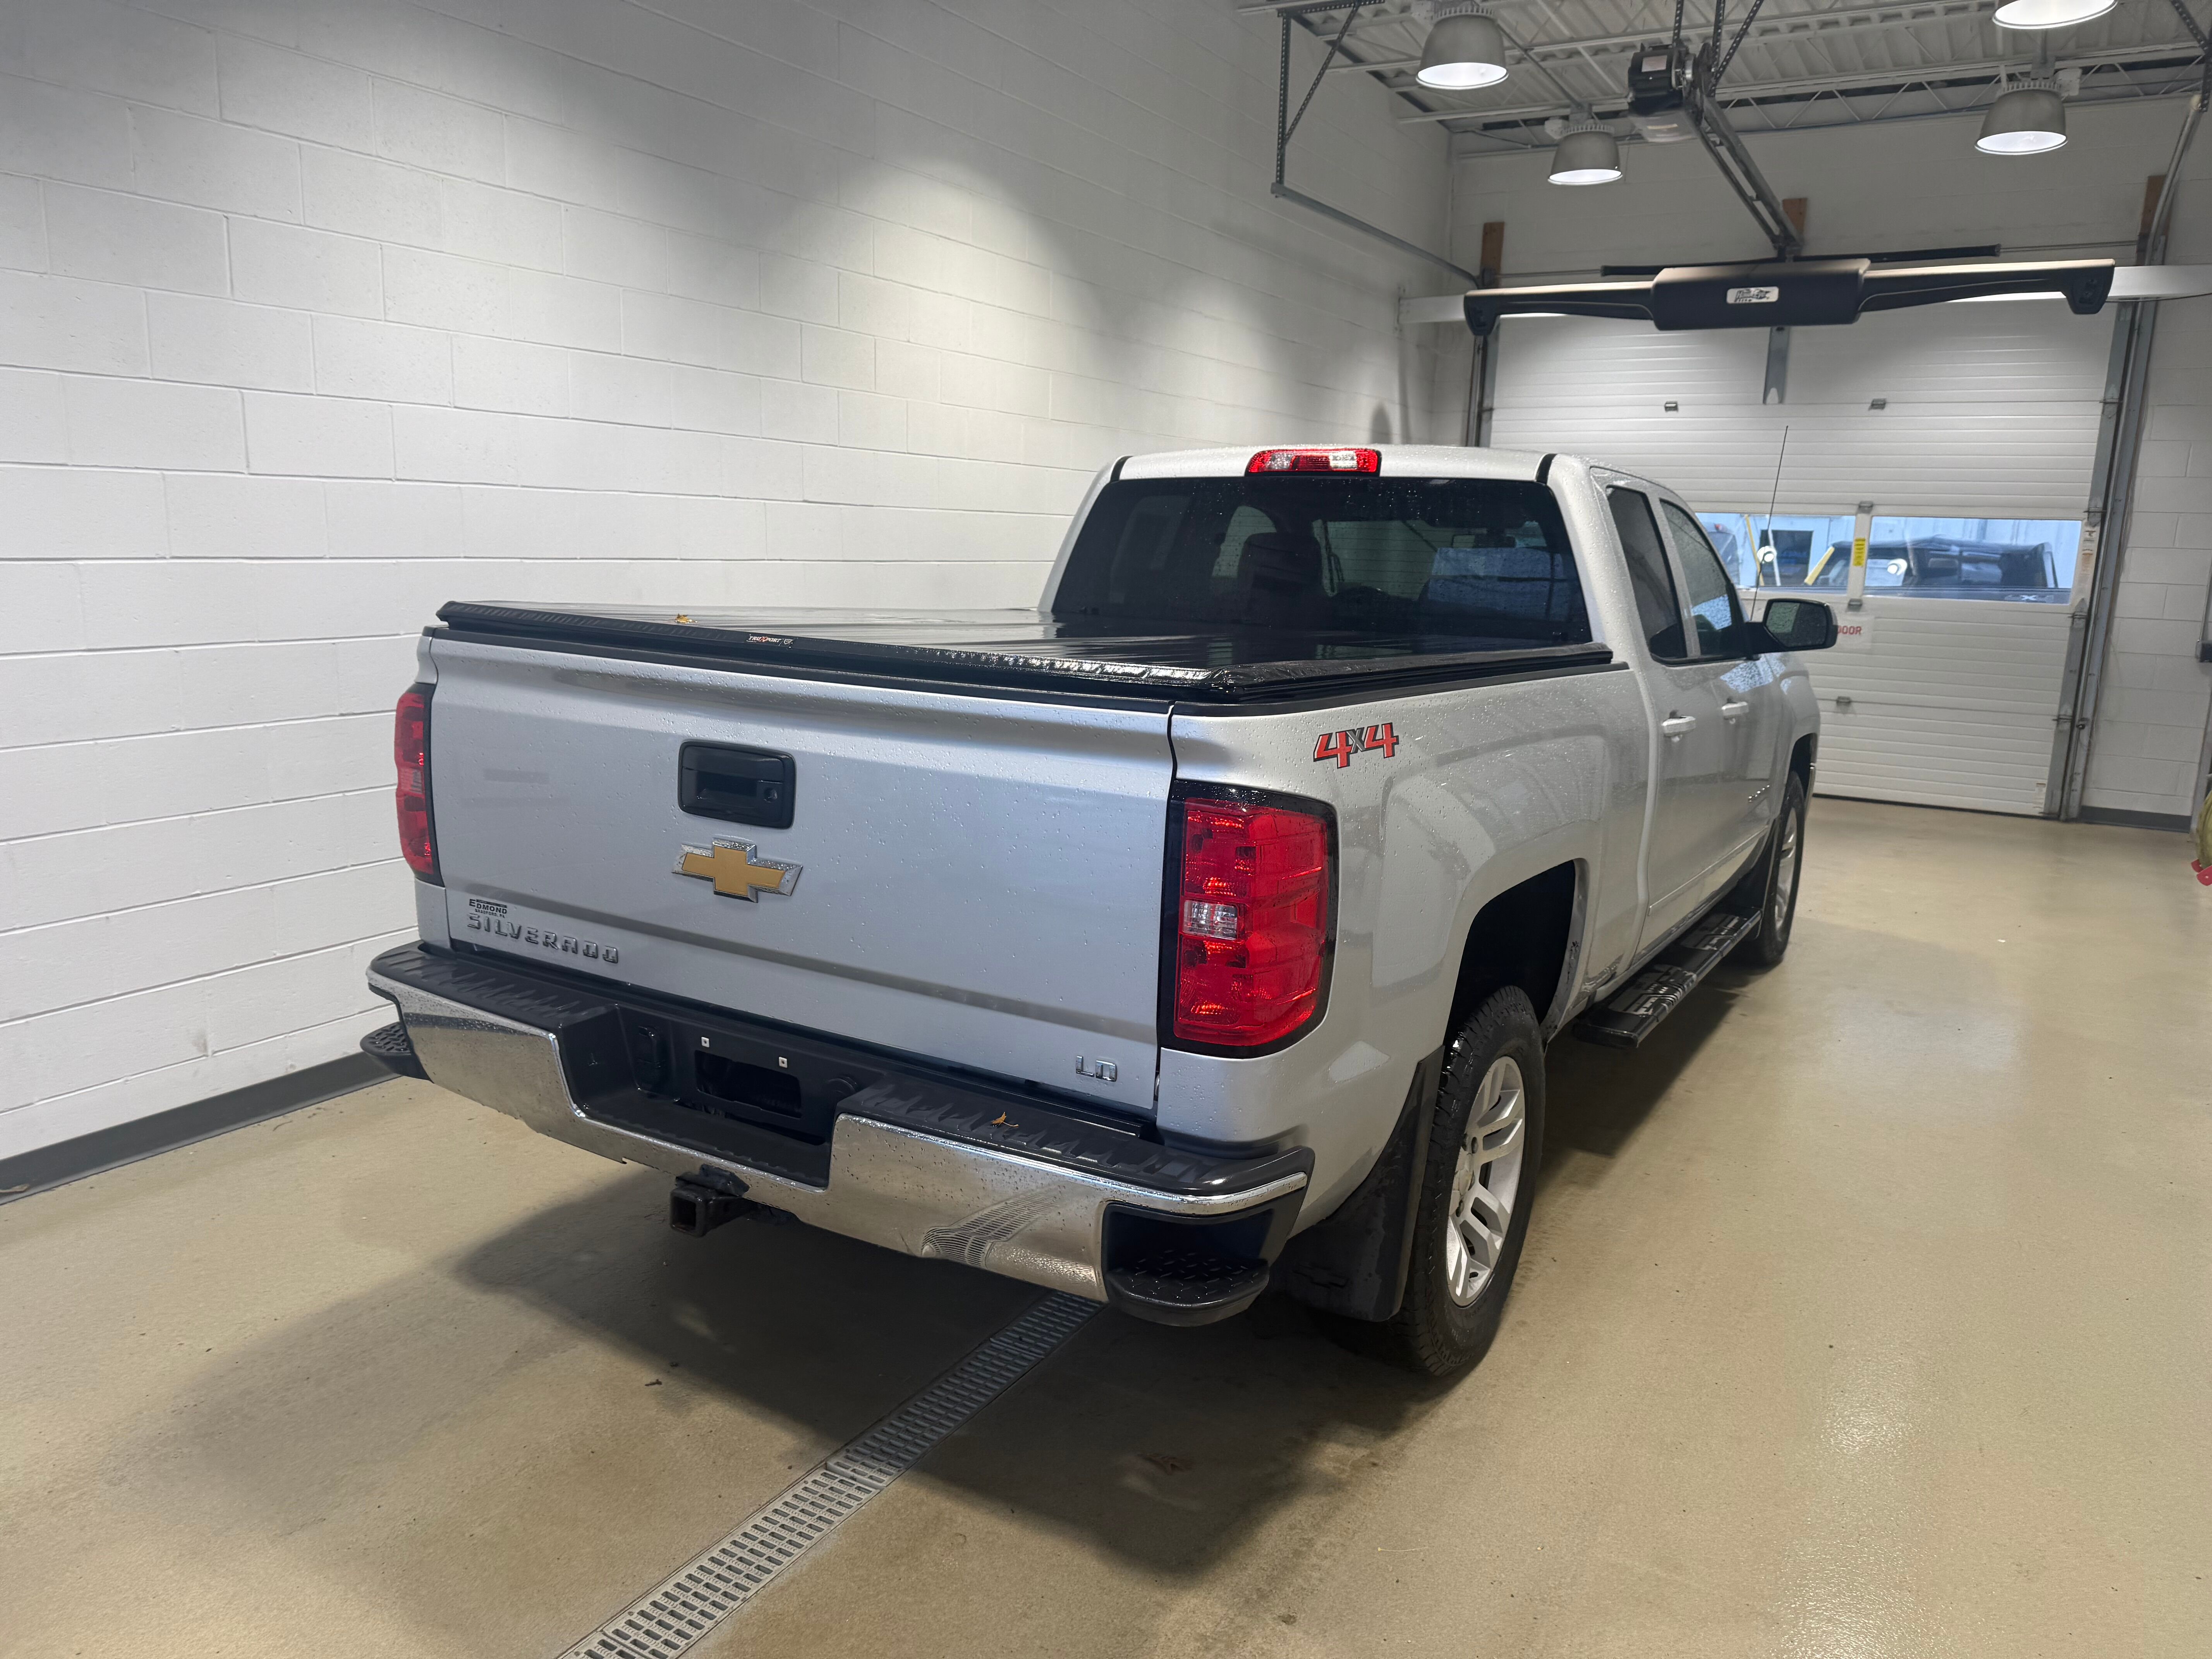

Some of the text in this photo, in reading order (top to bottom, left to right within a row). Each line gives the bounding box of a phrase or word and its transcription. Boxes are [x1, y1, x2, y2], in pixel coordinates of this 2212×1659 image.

[469, 899, 507, 914] EDMOND
[467, 913, 618, 963] SILVERADO
[1075, 1056, 1118, 1082] LD
